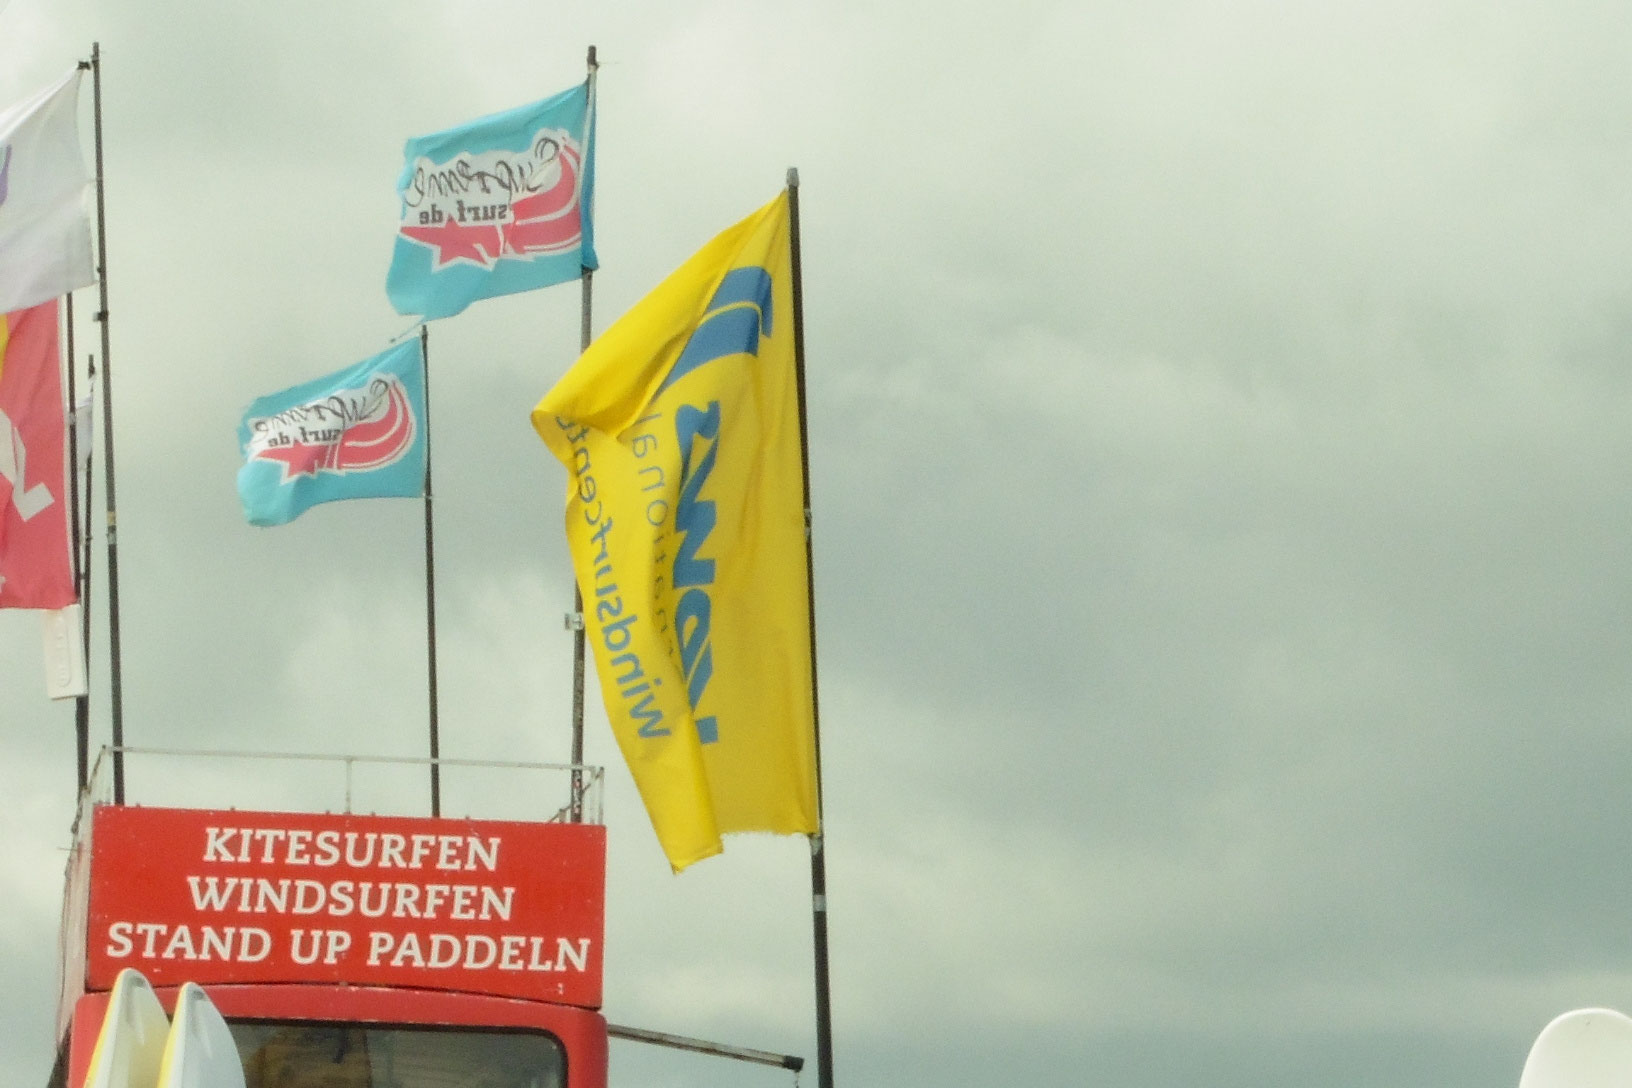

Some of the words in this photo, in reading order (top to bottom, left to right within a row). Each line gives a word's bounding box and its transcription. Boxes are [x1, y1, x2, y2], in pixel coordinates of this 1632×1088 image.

[203, 827, 502, 872] KITESURFEN
[186, 875, 516, 921] WINDSURFEN
[106, 921, 272, 963] STAND
[290, 929, 351, 965] UP
[366, 931, 592, 973] PADDELN
